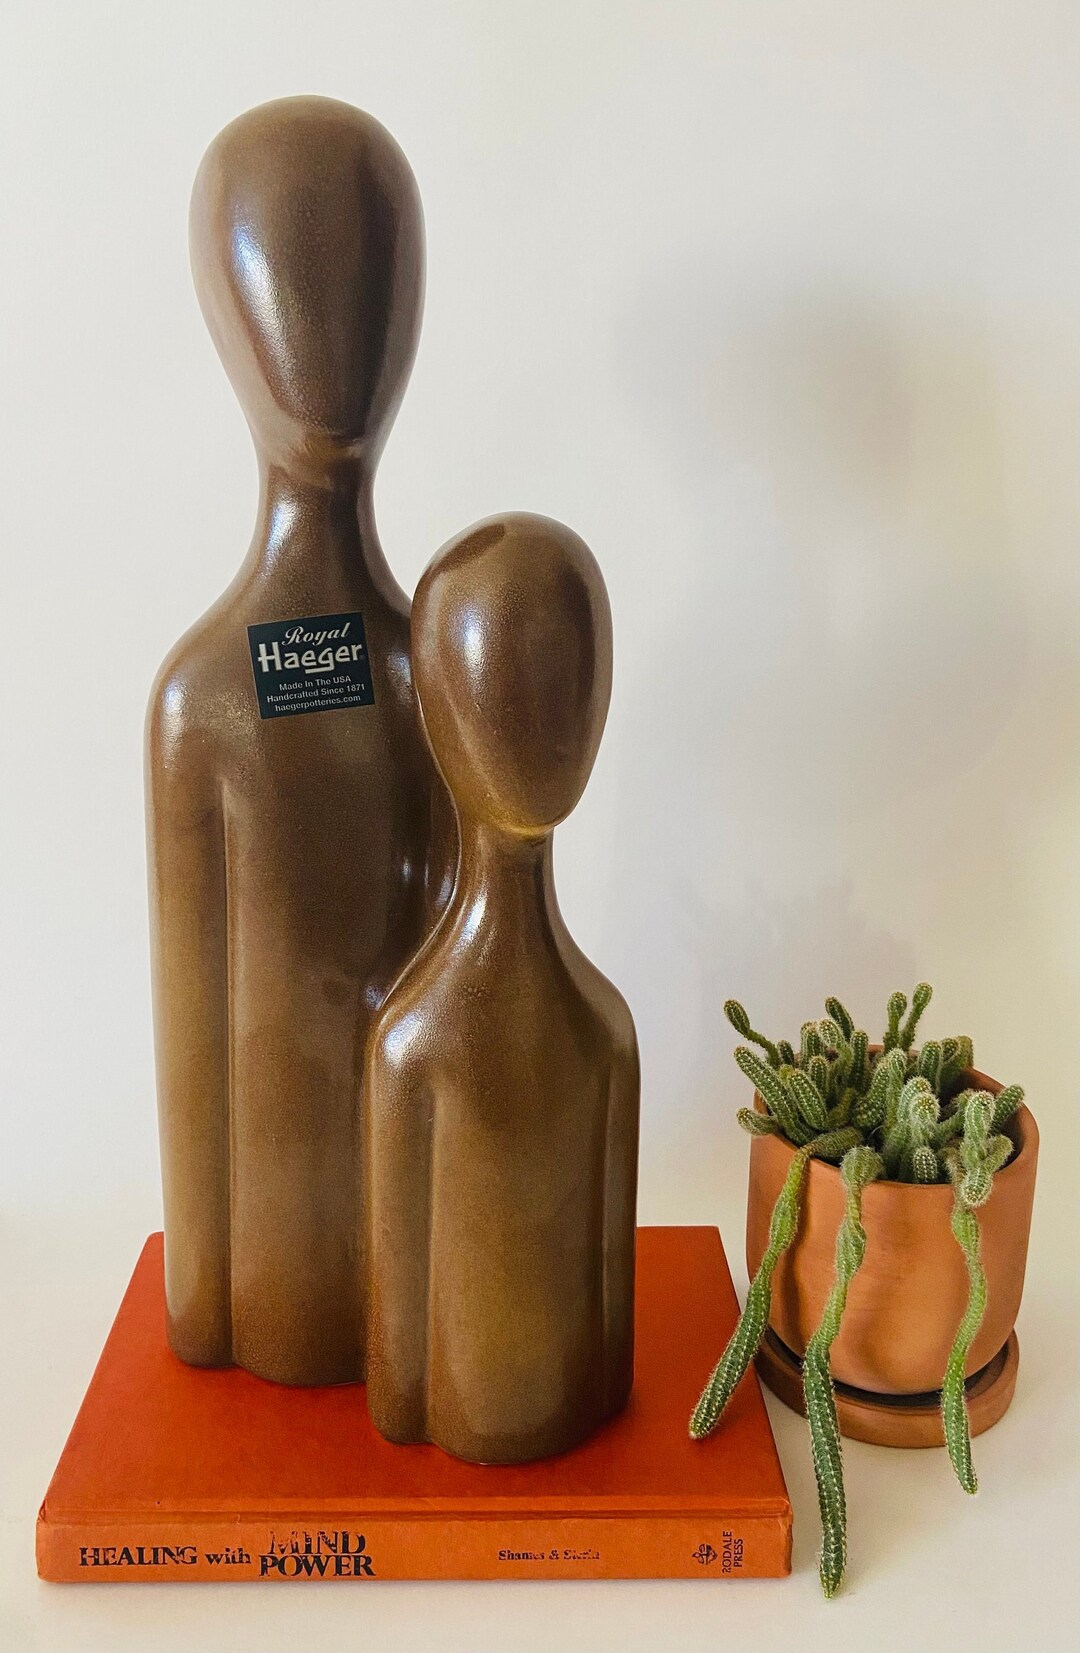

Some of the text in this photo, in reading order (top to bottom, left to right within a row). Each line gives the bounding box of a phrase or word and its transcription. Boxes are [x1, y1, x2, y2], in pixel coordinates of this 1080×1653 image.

[281, 622, 351, 646] Royal
[257, 641, 363, 674] Haeger
[266, 683, 366, 703] Handcrafted Since 1871
[279, 675, 352, 691] Made In The USA
[274, 694, 362, 712] haegerpotteries.com
[267, 1530, 366, 1554] MIND
[721, 1531, 733, 1573] RODALE
[733, 1538, 744, 1567] PRESS
[79, 1546, 251, 1566] HEALING with
[259, 1554, 376, 1576] POWER
[549, 1549, 560, 1560] &
